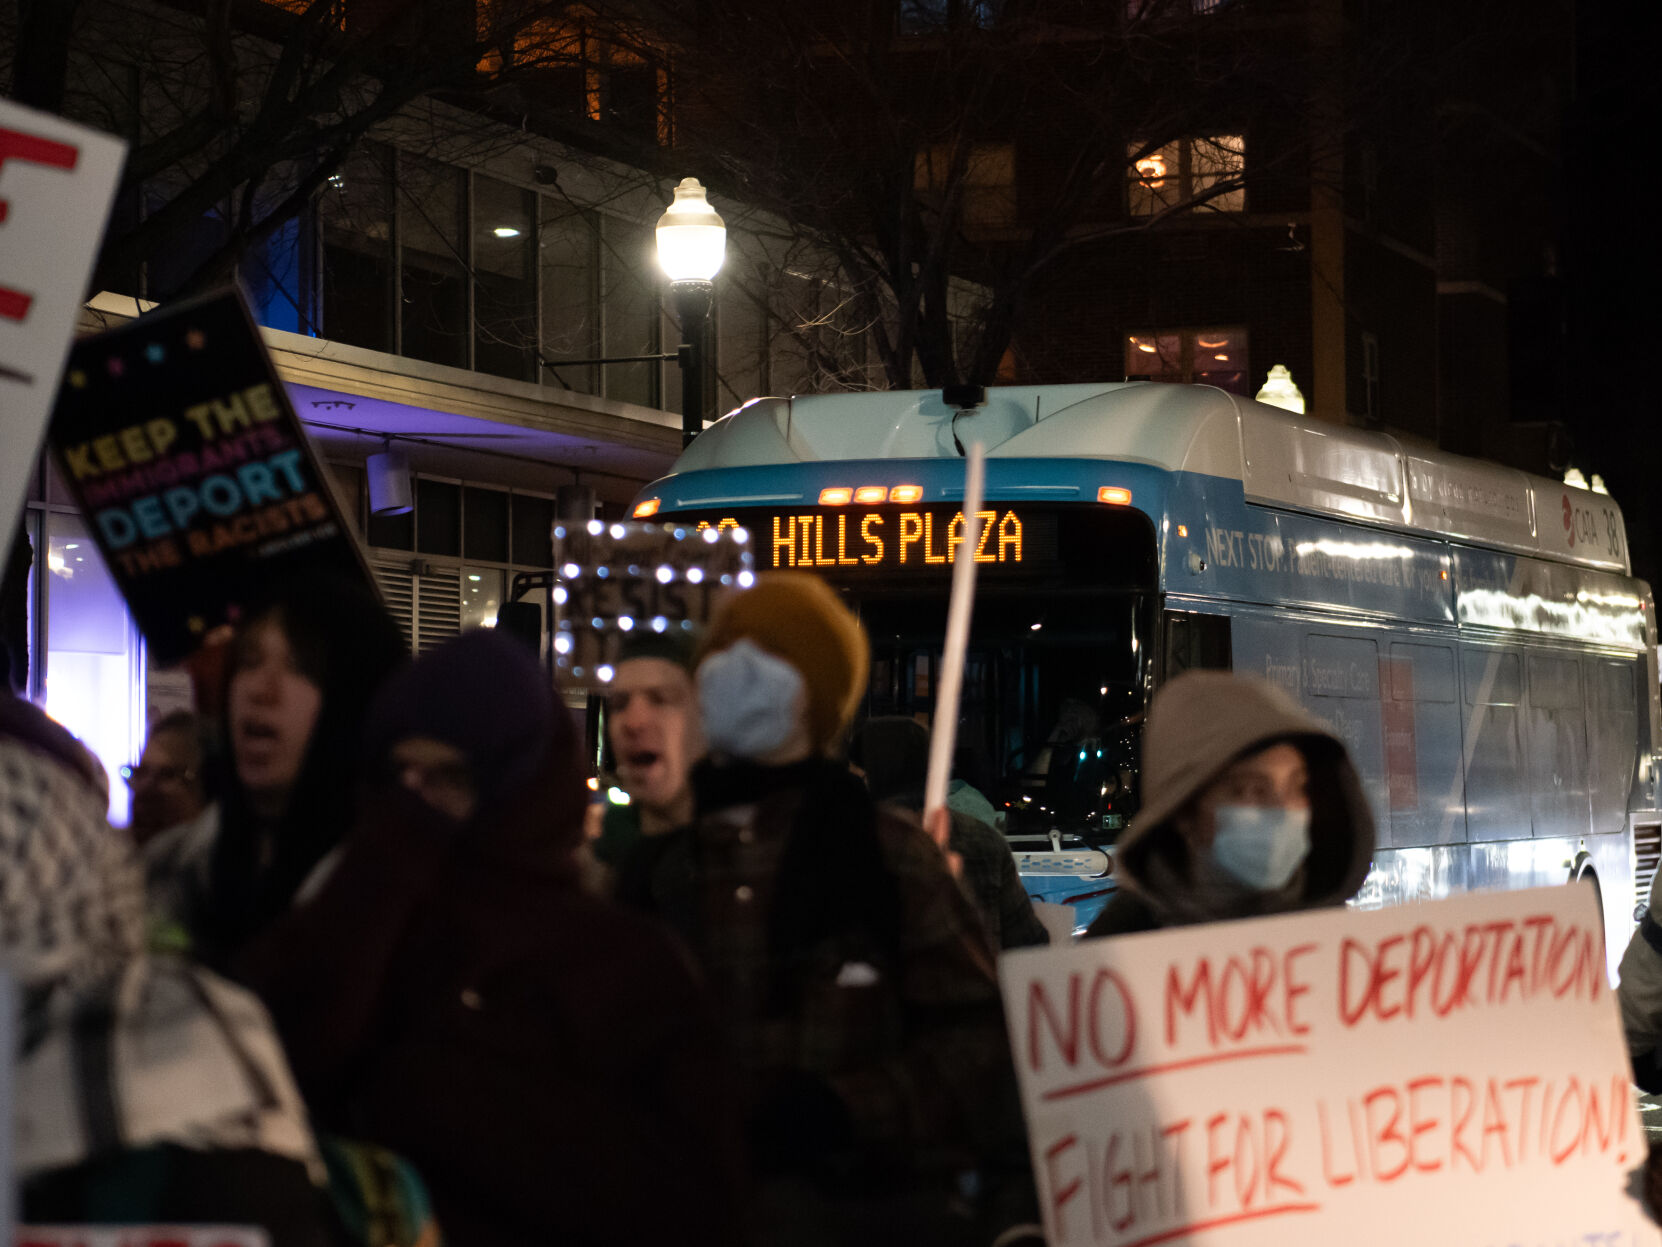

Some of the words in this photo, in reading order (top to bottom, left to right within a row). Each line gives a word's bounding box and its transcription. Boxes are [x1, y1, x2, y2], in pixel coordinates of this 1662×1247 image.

[64, 416, 178, 479] KEEP
[184, 383, 281, 442] THE
[96, 448, 307, 551] DEPORT
[773, 514, 884, 567] HILLS
[900, 510, 1022, 563] PLAZA
[1205, 527, 1244, 569] NEXT
[1028, 967, 1138, 1073] NO
[1163, 943, 1319, 1049] MORE
[1339, 914, 1602, 1030] DEPORTATION
[1046, 1118, 1194, 1243] FIGHT
[1206, 1107, 1306, 1213] FOR
[1316, 1072, 1629, 1188] LIBERATION!
